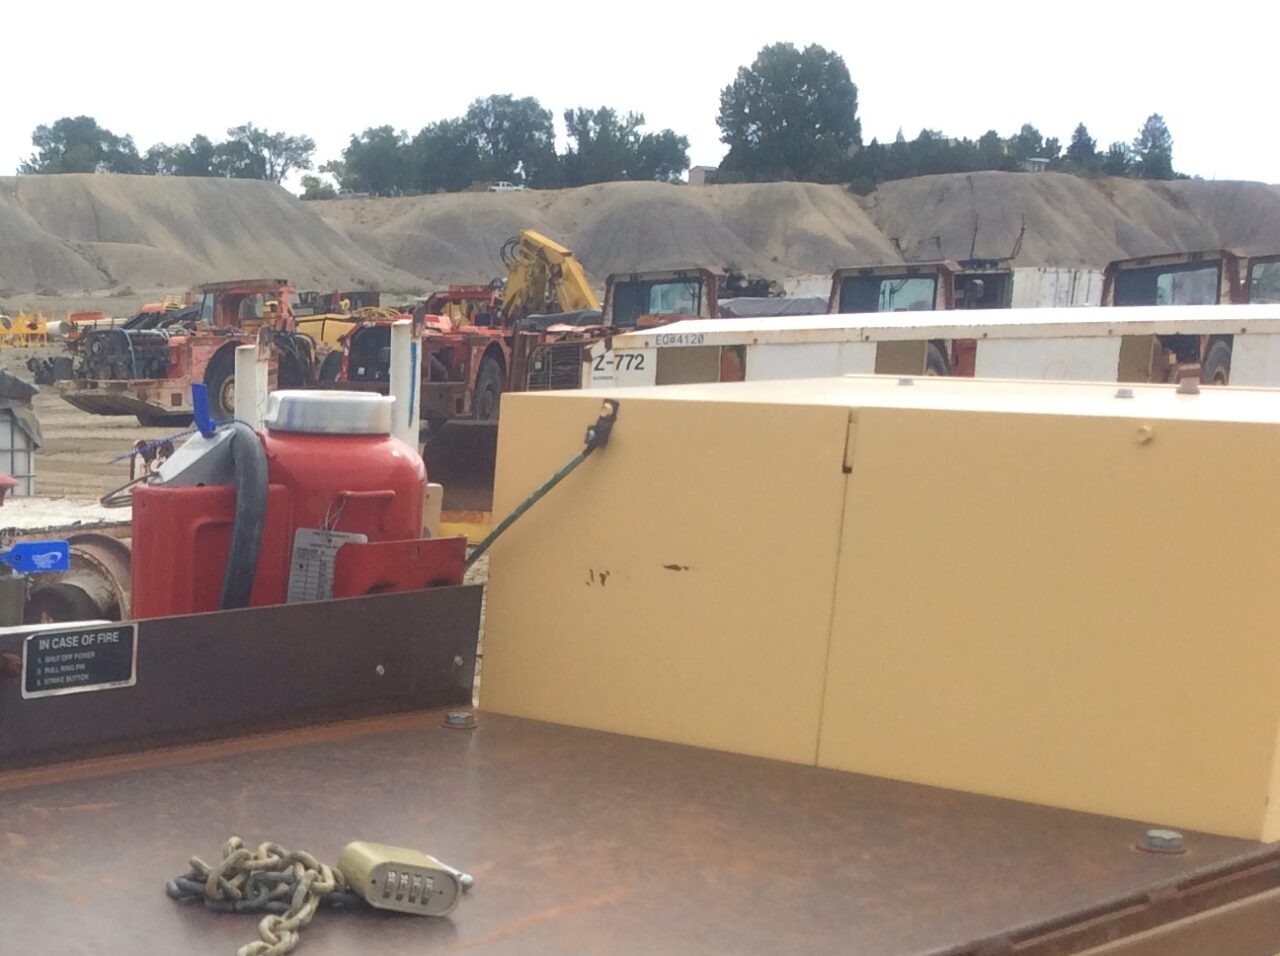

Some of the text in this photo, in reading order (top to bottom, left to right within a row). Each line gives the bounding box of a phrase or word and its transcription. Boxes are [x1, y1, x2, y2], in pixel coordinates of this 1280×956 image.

[593, 353, 645, 371] Z-772
[38, 631, 120, 651] IN CASE OF FIRE
